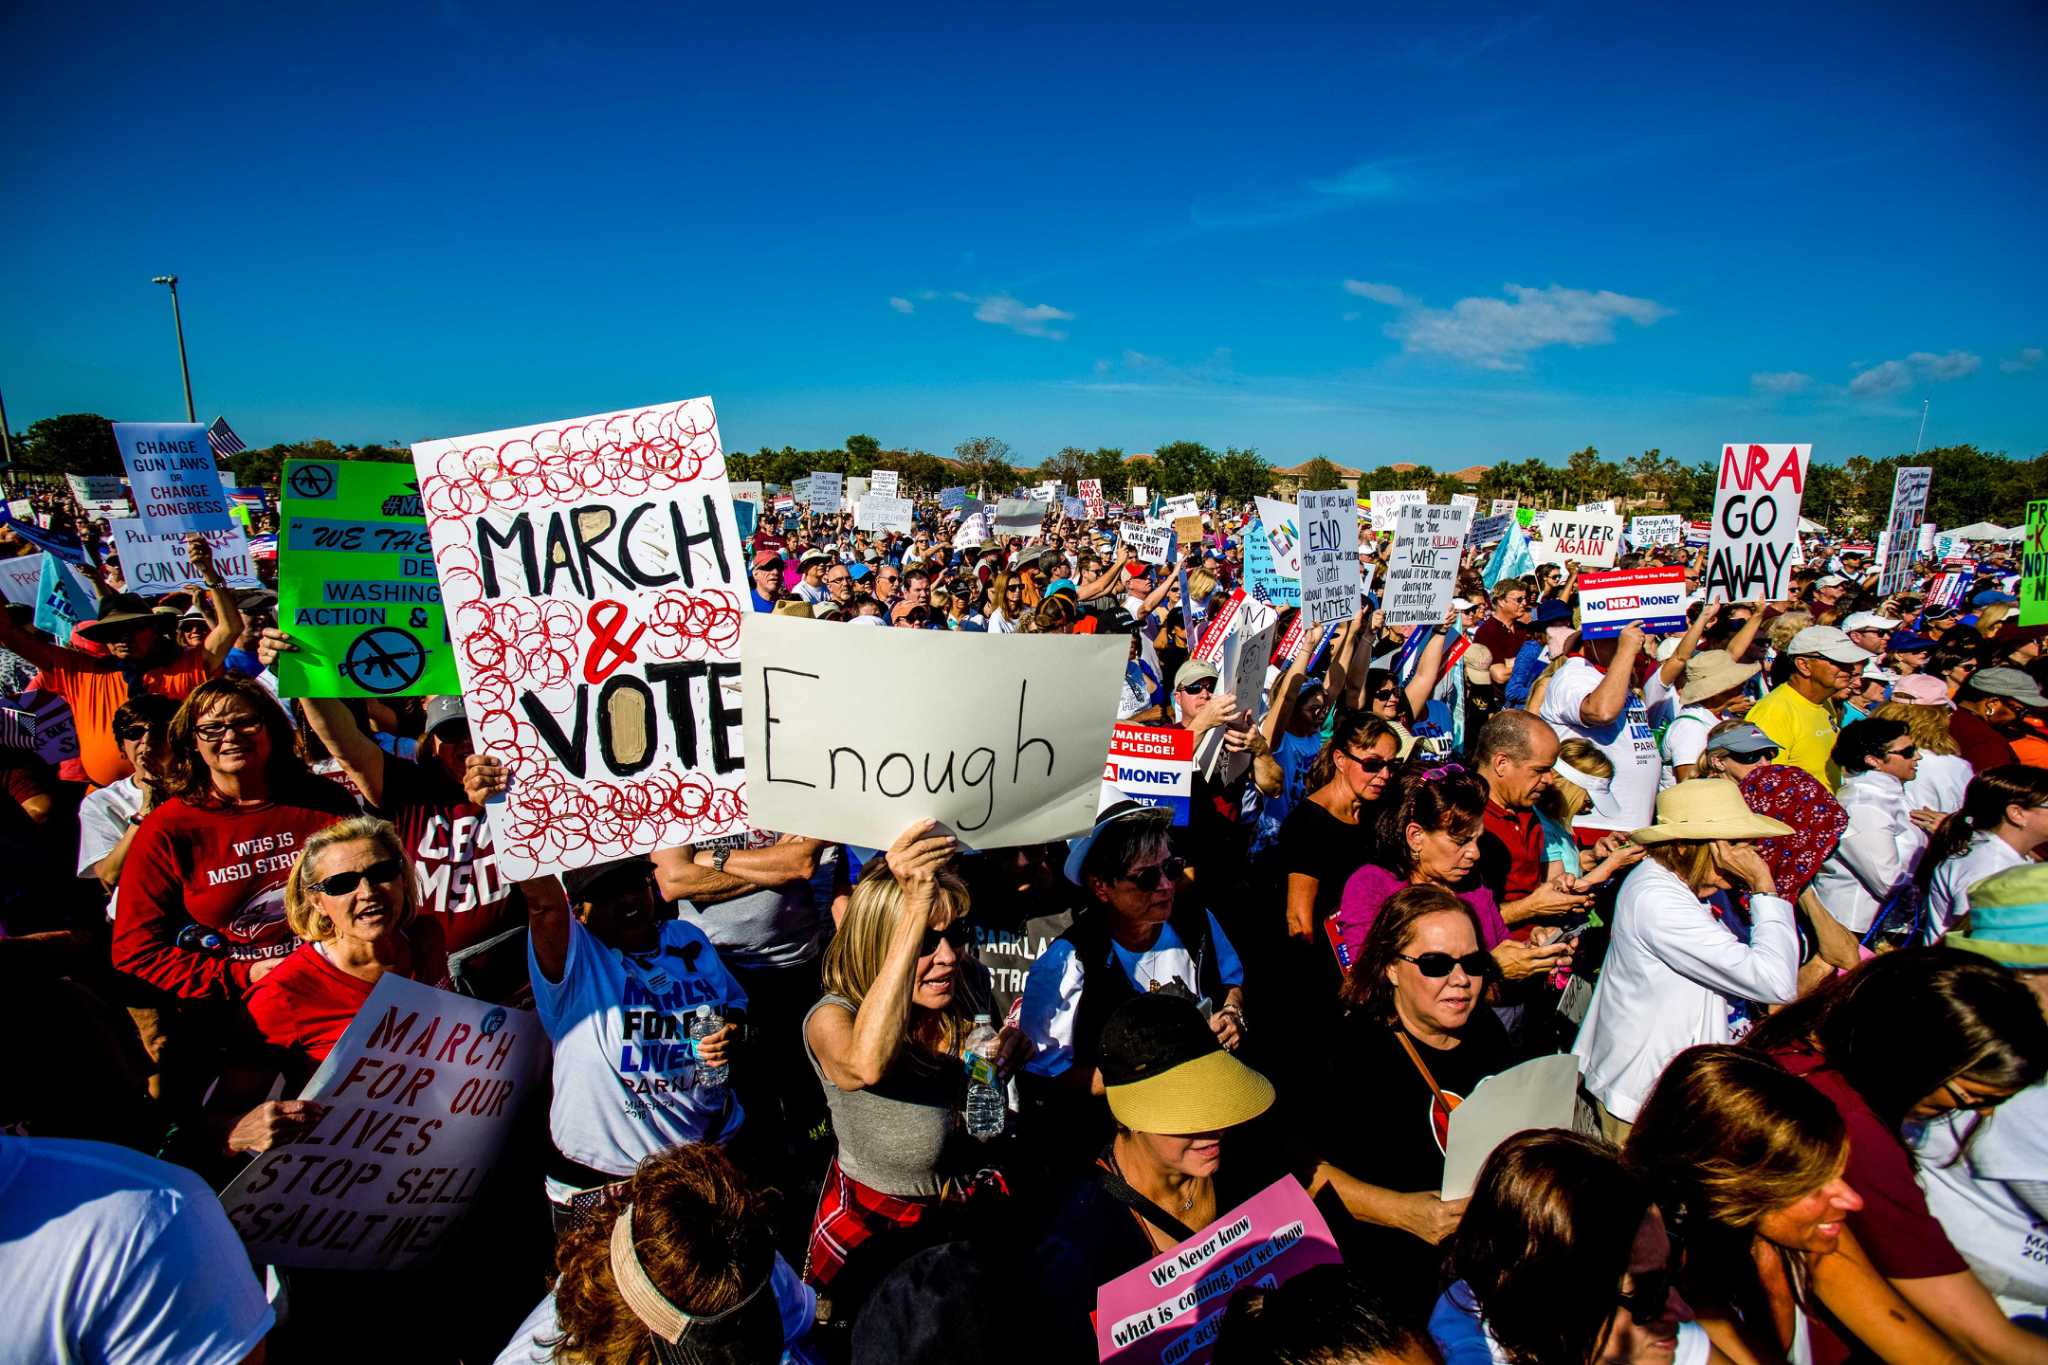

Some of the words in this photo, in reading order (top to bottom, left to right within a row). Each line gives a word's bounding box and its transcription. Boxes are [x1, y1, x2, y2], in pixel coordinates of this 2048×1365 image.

[136, 441, 198, 455] CHANGE
[133, 458, 166, 472] GUN
[172, 457, 210, 471] LAWS
[1720, 445, 1802, 494] NRA
[170, 473, 183, 482] OR
[1080, 480, 1096, 489] NRA
[151, 484, 209, 500] CHANGE
[1080, 488, 1101, 498] PAYS
[146, 501, 224, 517] CONGRESS
[1339, 496, 1355, 512] begin
[1412, 505, 1422, 519] the
[1428, 508, 1441, 524] gun
[1443, 507, 1450, 519] is
[1451, 509, 1462, 522] not
[1636, 518, 1659, 527] Keep
[1660, 518, 1674, 526] My
[1722, 495, 1777, 539] GO
[1309, 520, 1341, 549] END
[1414, 521, 1425, 533] the
[1550, 522, 1614, 541] NEVER
[1637, 526, 1679, 535] Students
[477, 494, 731, 600] MARCH
[1128, 533, 1144, 542] ARE
[1146, 536, 1160, 545] NOT
[1431, 536, 1459, 548] KILLING
[1555, 538, 1605, 556] AGAIN
[1304, 553, 1317, 566] the
[1322, 551, 1333, 564] day
[1410, 549, 1439, 566] WHY
[136, 562, 176, 583] GUN
[1317, 566, 1340, 582] silent
[1391, 567, 1412, 579] would
[1420, 568, 1428, 579] be
[1430, 568, 1440, 579] the
[1706, 542, 1794, 603] AWAY
[1304, 587, 1322, 601] about
[1402, 580, 1421, 595] doing
[1587, 600, 1607, 611] NO
[1607, 596, 1638, 610] NRA
[1640, 594, 1681, 606] MONEY
[295, 608, 386, 626] ACTION
[409, 607, 428, 629] &
[583, 599, 647, 685] &
[519, 662, 745, 778] VOTE
[763, 667, 1055, 831] Enough
[1121, 742, 1175, 755] PLEDGE!
[1119, 767, 1181, 784] MONEY
[233, 836, 274, 857] WHS
[276, 831, 294, 847] IS
[207, 862, 251, 886] MSD
[415, 854, 511, 912] MSD
[366, 1006, 516, 1071] MARCH
[333, 1057, 435, 1107] FOR
[449, 1077, 514, 1117] OUR
[296, 1105, 443, 1157] LIVES
[246, 1153, 382, 1199] STOP
[1151, 1264, 1177, 1286] We
[1179, 1239, 1217, 1272] Never
[1219, 1217, 1250, 1247] know
[1115, 1312, 1156, 1347] what
[1158, 1306, 1174, 1325] is
[1178, 1271, 1234, 1311] coming,
[1233, 1255, 1256, 1278] but
[1256, 1244, 1274, 1261] we
[1273, 1221, 1304, 1253] know
